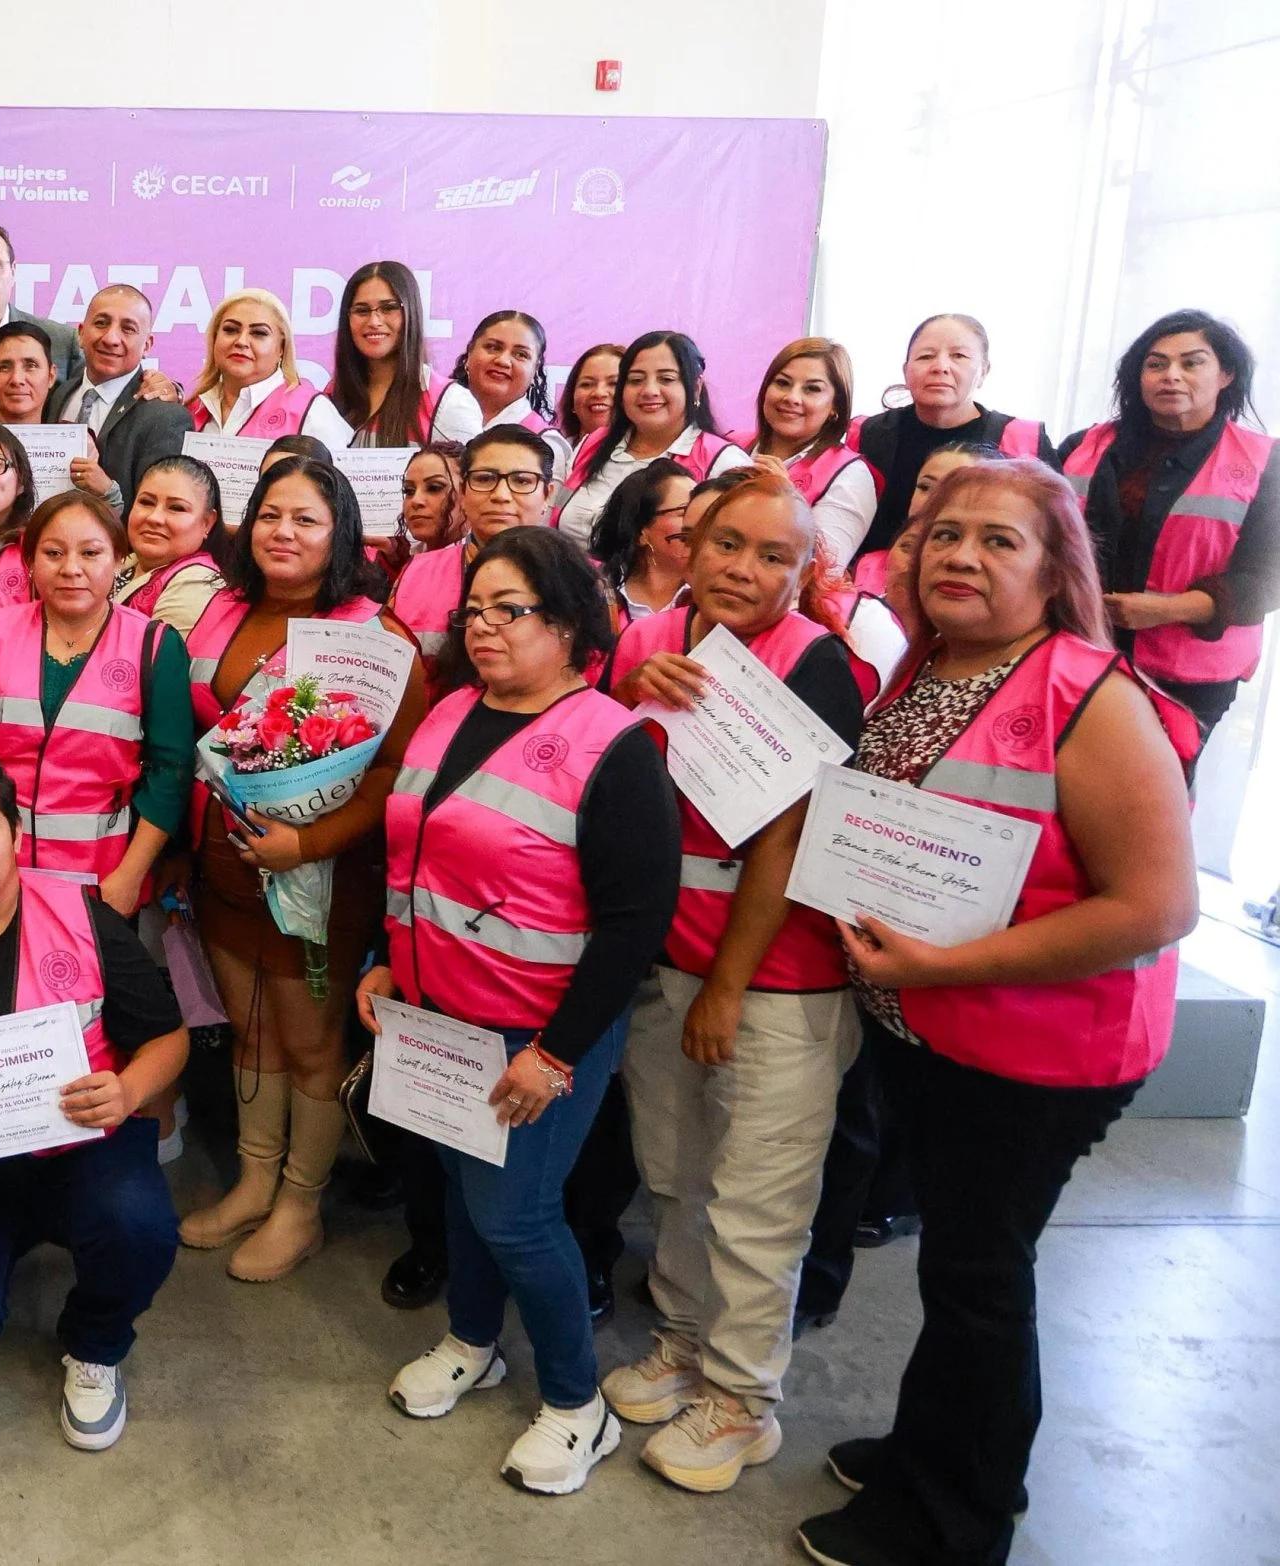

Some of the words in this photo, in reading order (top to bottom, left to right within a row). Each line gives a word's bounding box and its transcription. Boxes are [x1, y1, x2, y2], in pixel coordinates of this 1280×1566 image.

[12, 186, 90, 202] Volante
[171, 175, 269, 196] CECATI
[319, 194, 381, 210] conalep
[292, 267, 453, 338] DL
[315, 654, 397, 682] RECONOCIMIENTO
[706, 676, 792, 762] RECONOCIMIENTO
[844, 813, 982, 868] RECONOCIMIENTO
[399, 1033, 483, 1072] RECONOCIMIENTO
